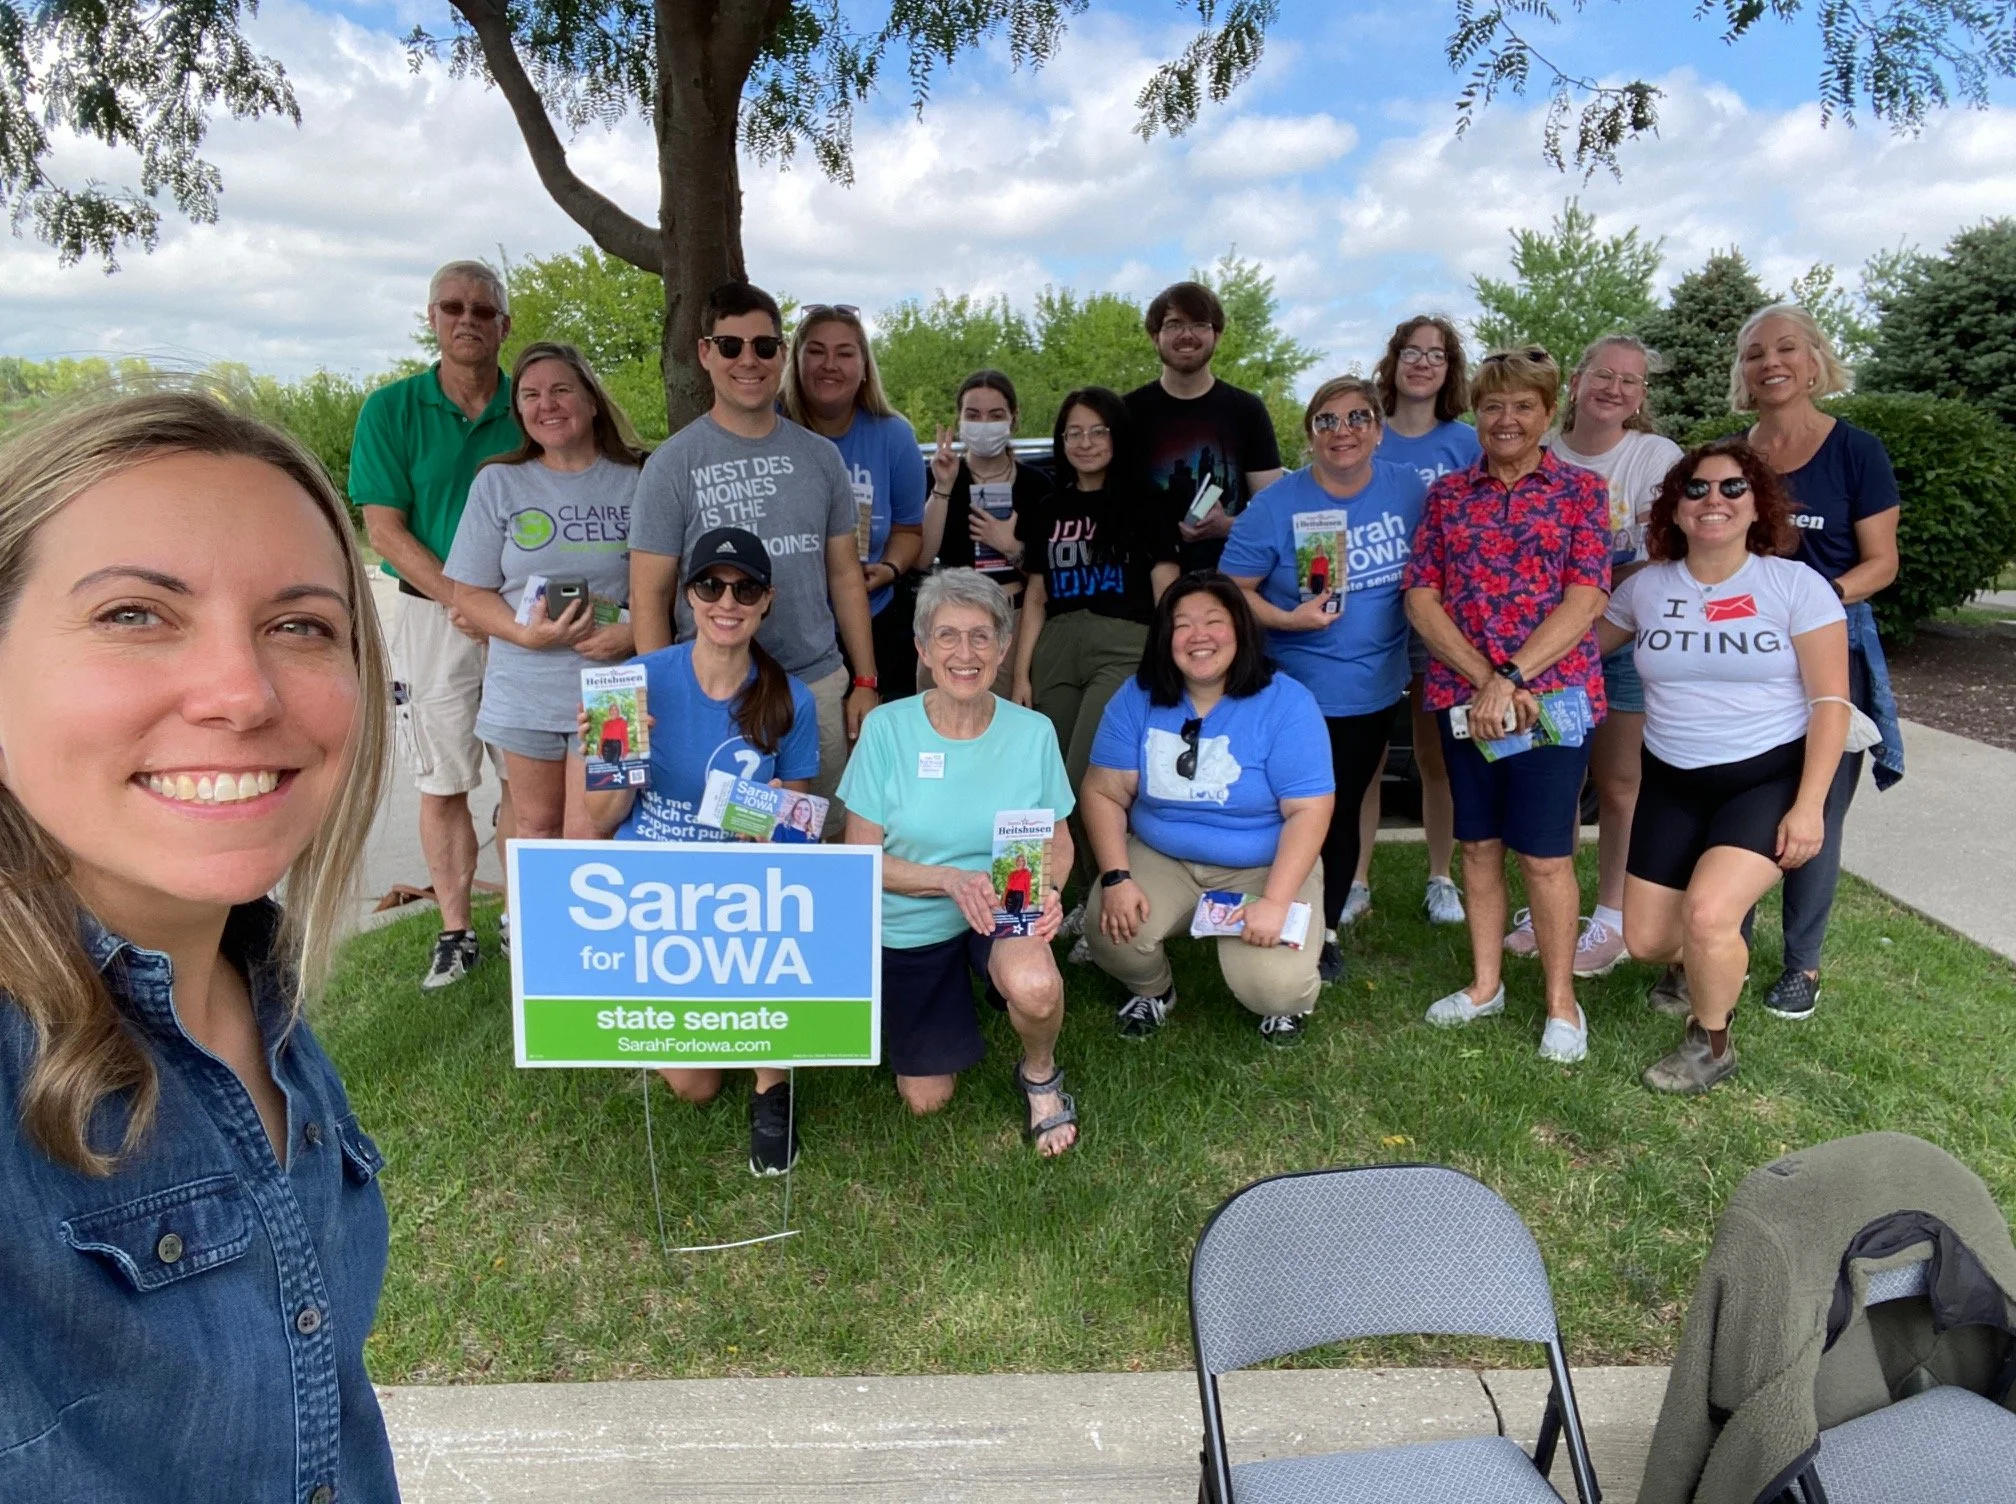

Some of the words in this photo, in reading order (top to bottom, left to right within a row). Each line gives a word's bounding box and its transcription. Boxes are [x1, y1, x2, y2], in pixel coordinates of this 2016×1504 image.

[691, 459, 748, 488] WEST
[752, 456, 794, 476] DES
[696, 477, 777, 508] MOINES
[558, 505, 631, 521] CLAIRE
[701, 508, 721, 528] IS
[725, 499, 766, 522] THE
[563, 522, 631, 542] CELS
[1346, 511, 1406, 549] arah
[1348, 538, 1412, 571] OWA
[1663, 599, 1688, 618] I
[737, 781, 778, 804] Sarah
[666, 798, 693, 811] me
[743, 796, 773, 814] IOWA
[998, 825, 1052, 836] Heitshusen
[568, 862, 815, 933] Sarah
[580, 945, 626, 970] for
[635, 935, 814, 985] IOWA
[597, 1006, 676, 1030] state
[683, 1006, 789, 1030] senate
[618, 1037, 771, 1053] SarahForIowa.com
